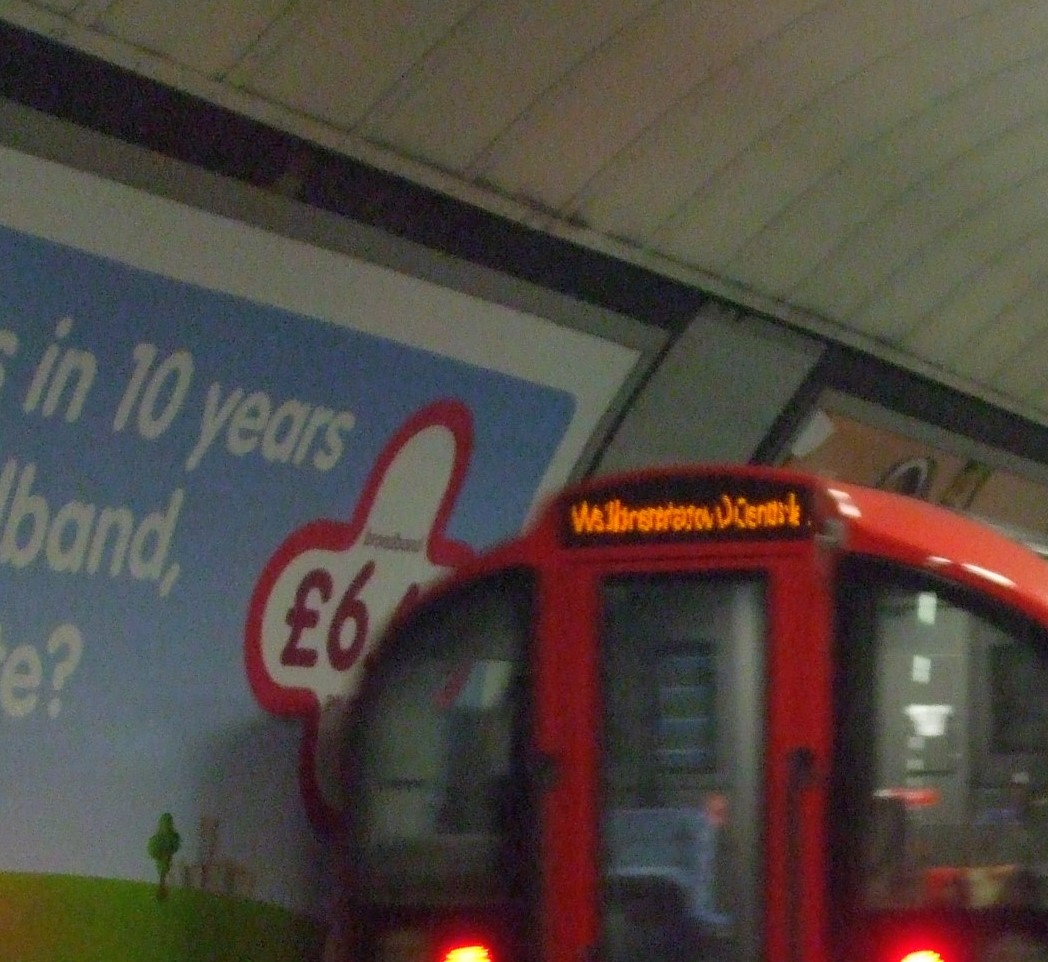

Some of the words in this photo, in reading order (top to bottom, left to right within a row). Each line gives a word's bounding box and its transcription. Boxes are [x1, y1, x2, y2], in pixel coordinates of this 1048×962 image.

[23, 317, 97, 423] in
[113, 343, 194, 440] 10
[185, 381, 355, 472] years
